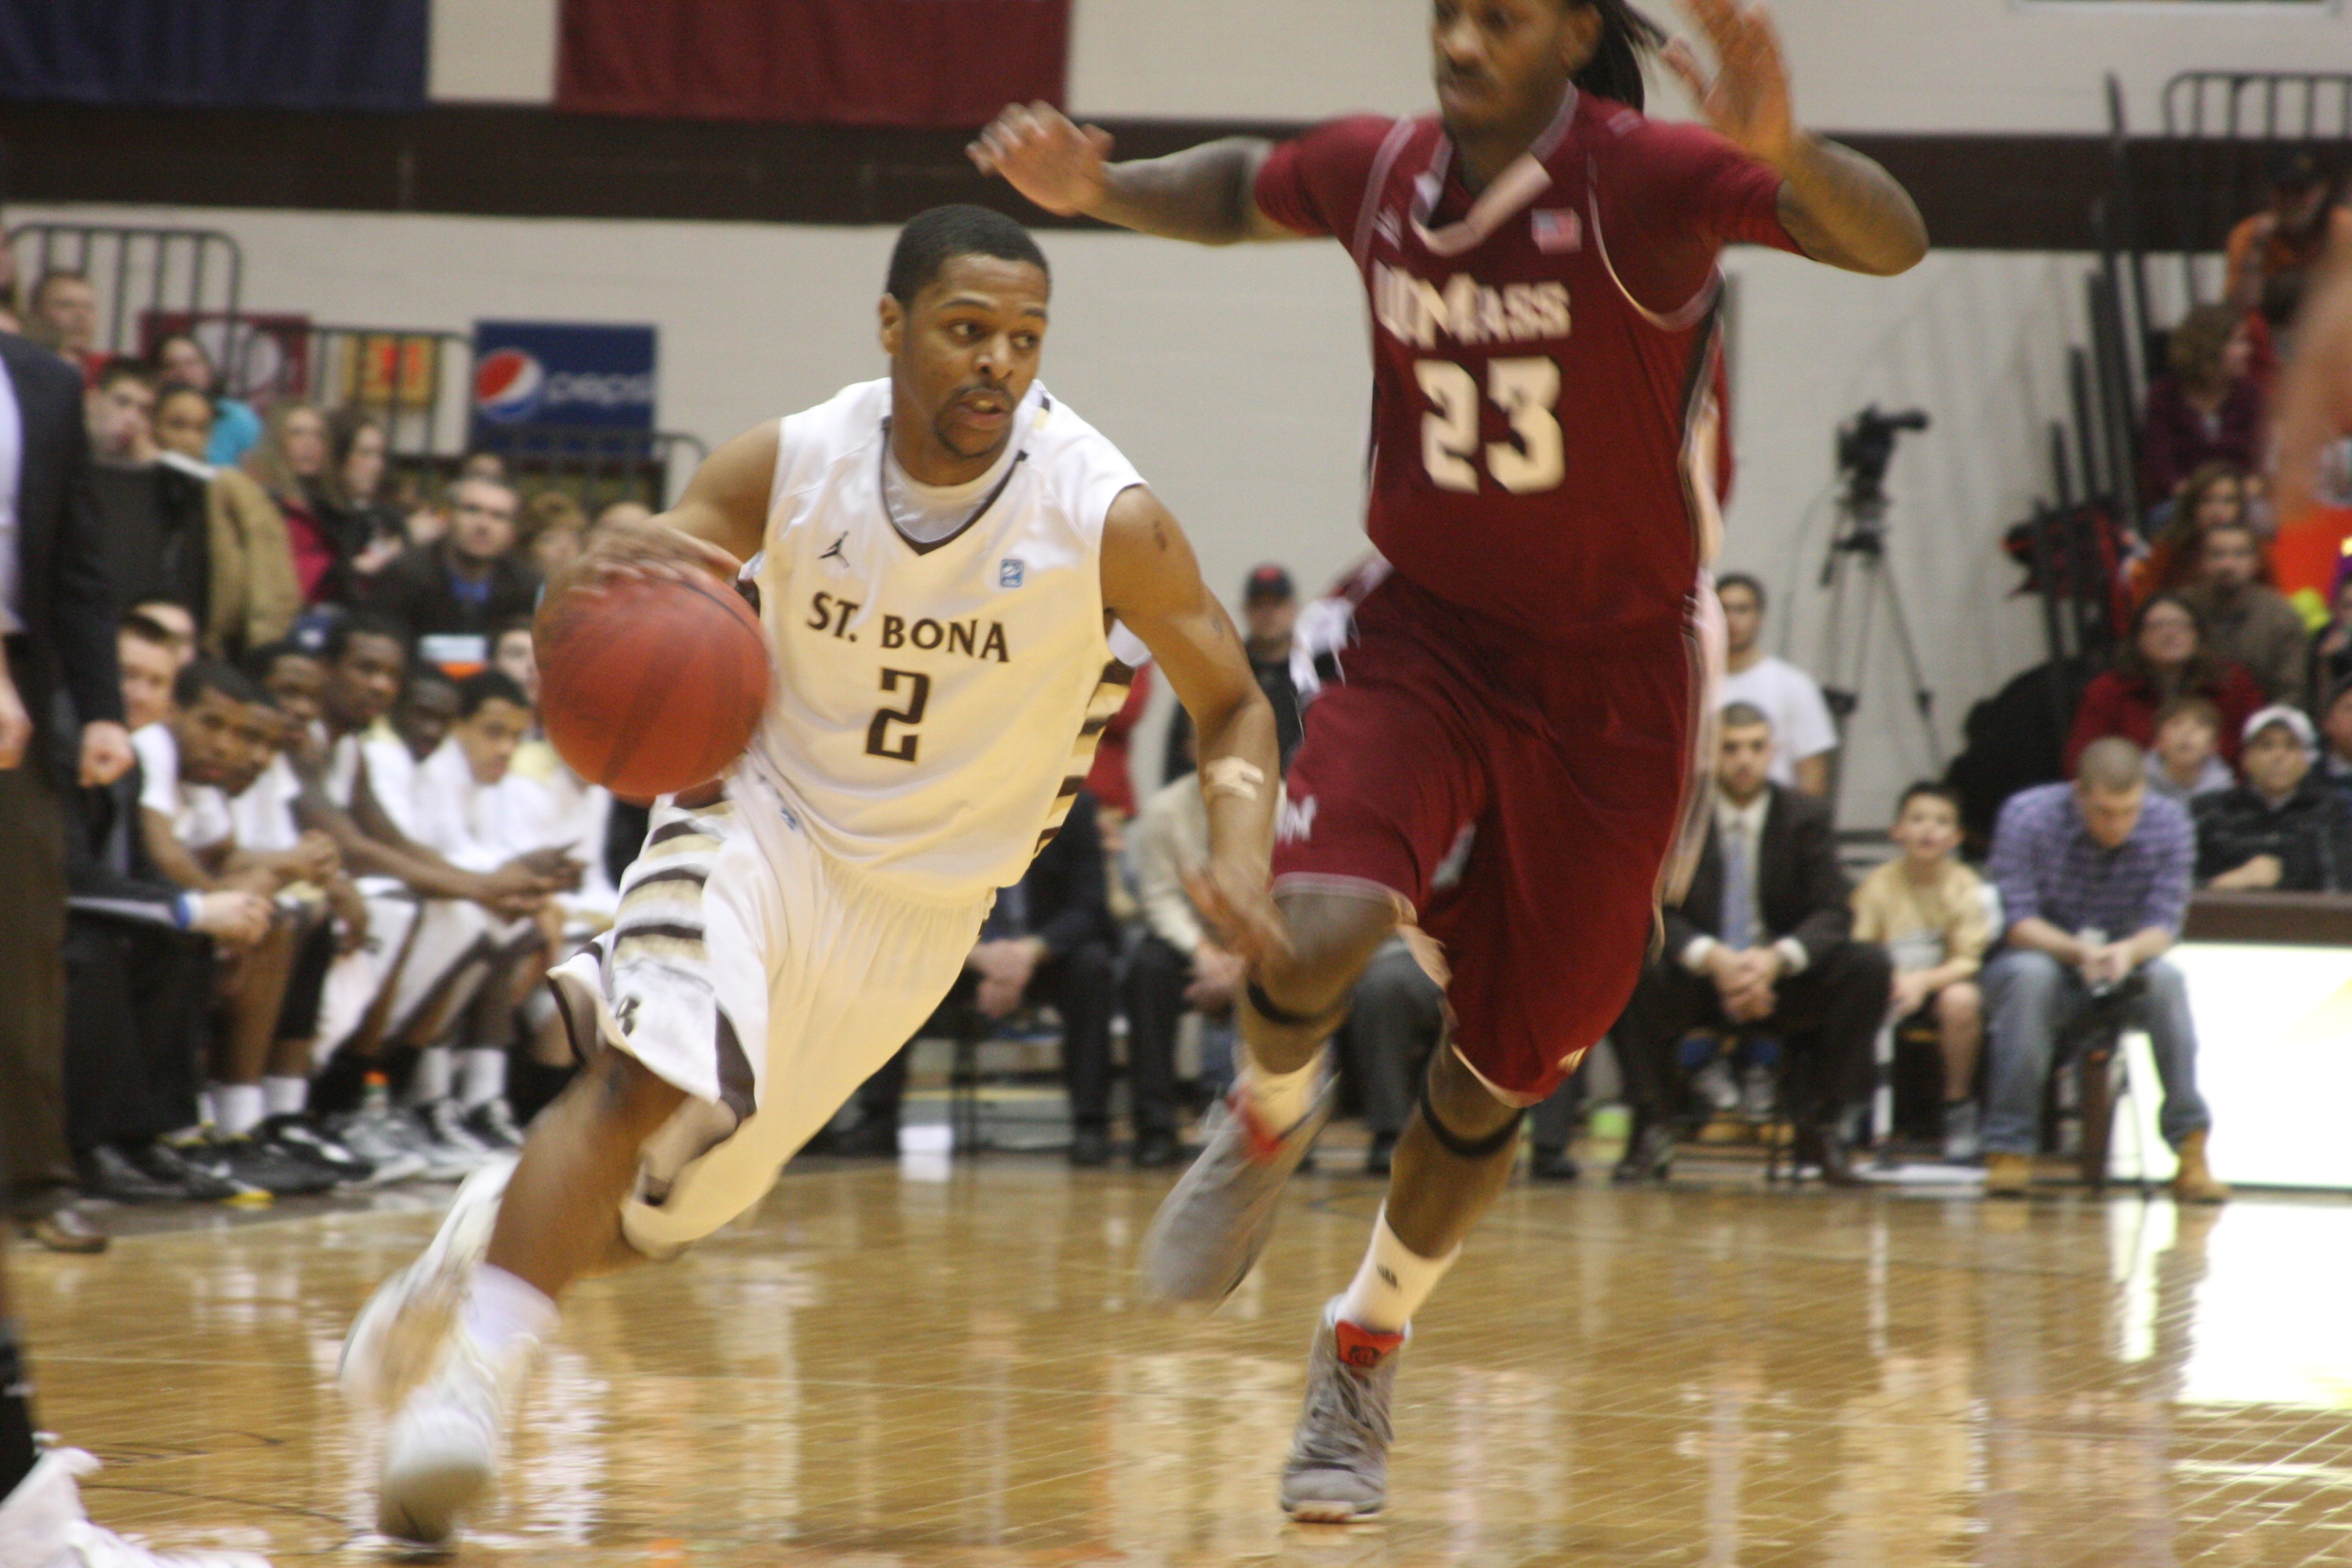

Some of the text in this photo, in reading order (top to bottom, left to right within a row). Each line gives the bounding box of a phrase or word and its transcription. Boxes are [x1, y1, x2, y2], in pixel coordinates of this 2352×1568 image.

[1414, 357, 1565, 495] 23
[806, 591, 1010, 663] ST. BONA
[864, 667, 930, 762] 2
